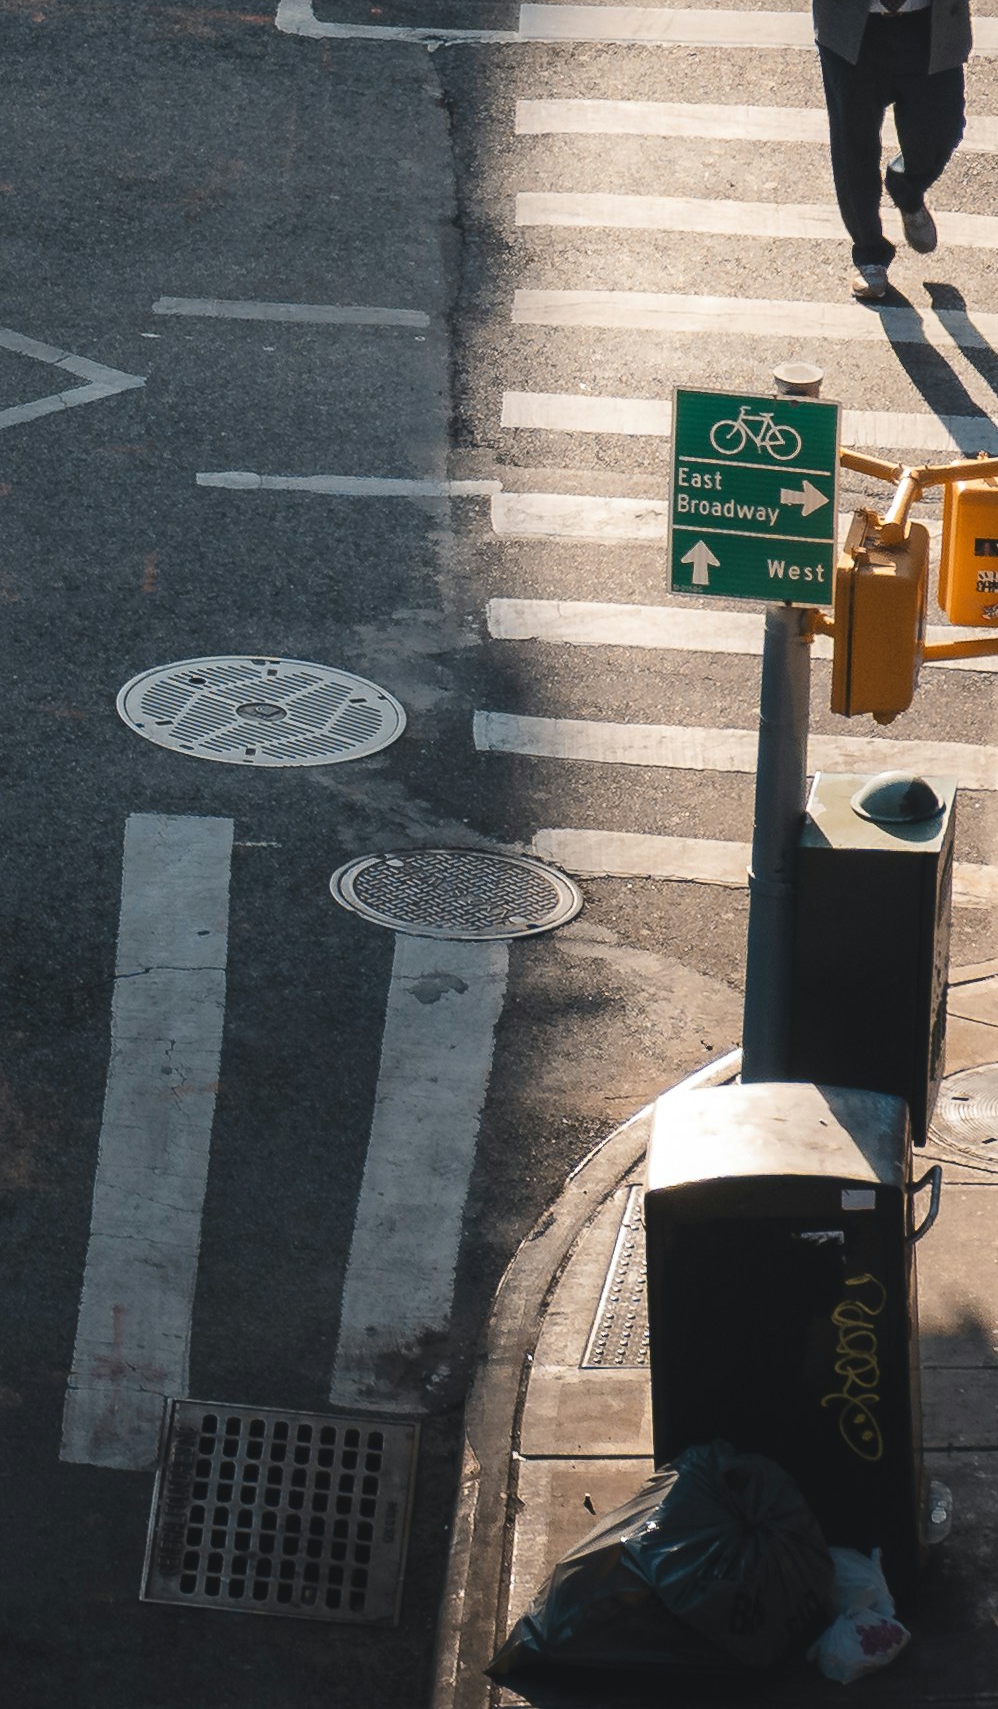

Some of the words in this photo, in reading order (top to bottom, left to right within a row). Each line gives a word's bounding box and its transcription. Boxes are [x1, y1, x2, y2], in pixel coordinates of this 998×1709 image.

[678, 468, 722, 491] East
[677, 495, 780, 527] Broadway
[767, 559, 825, 582] West
